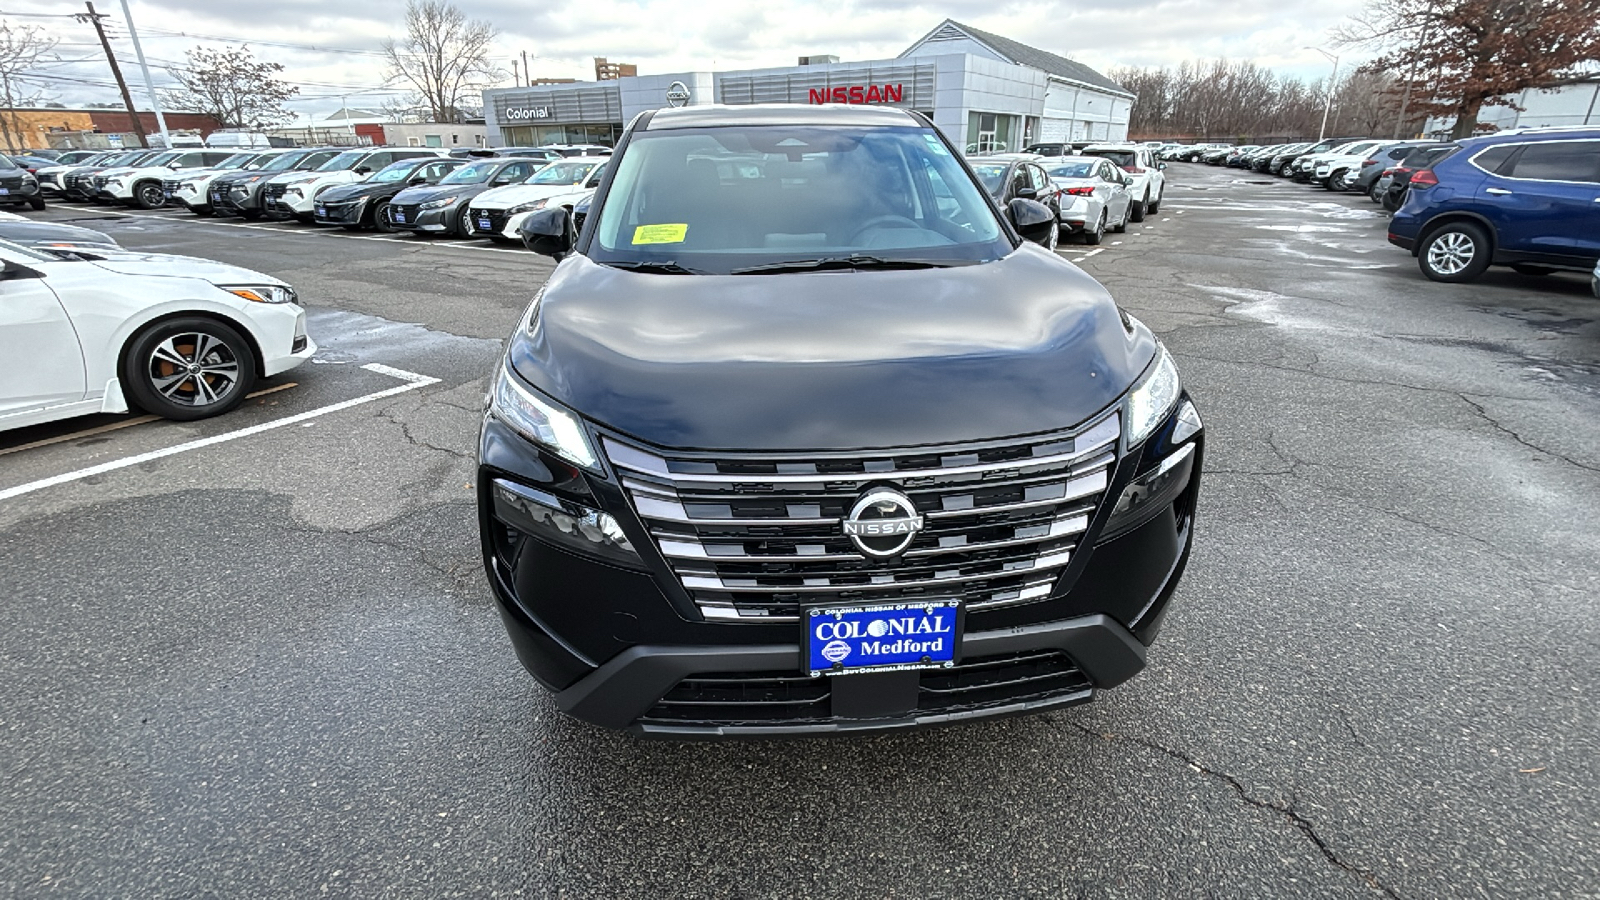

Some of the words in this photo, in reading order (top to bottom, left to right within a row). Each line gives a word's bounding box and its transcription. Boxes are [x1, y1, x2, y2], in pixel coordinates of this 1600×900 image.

[809, 83, 903, 105] NISSAN
[506, 106, 549, 119] Colonial
[844, 519, 922, 534] NISSAN
[824, 607, 864, 616] COLONIAL
[865, 605, 894, 613] NISSAN
[908, 602, 945, 610] MEDFORD
[860, 637, 943, 656] Medford
